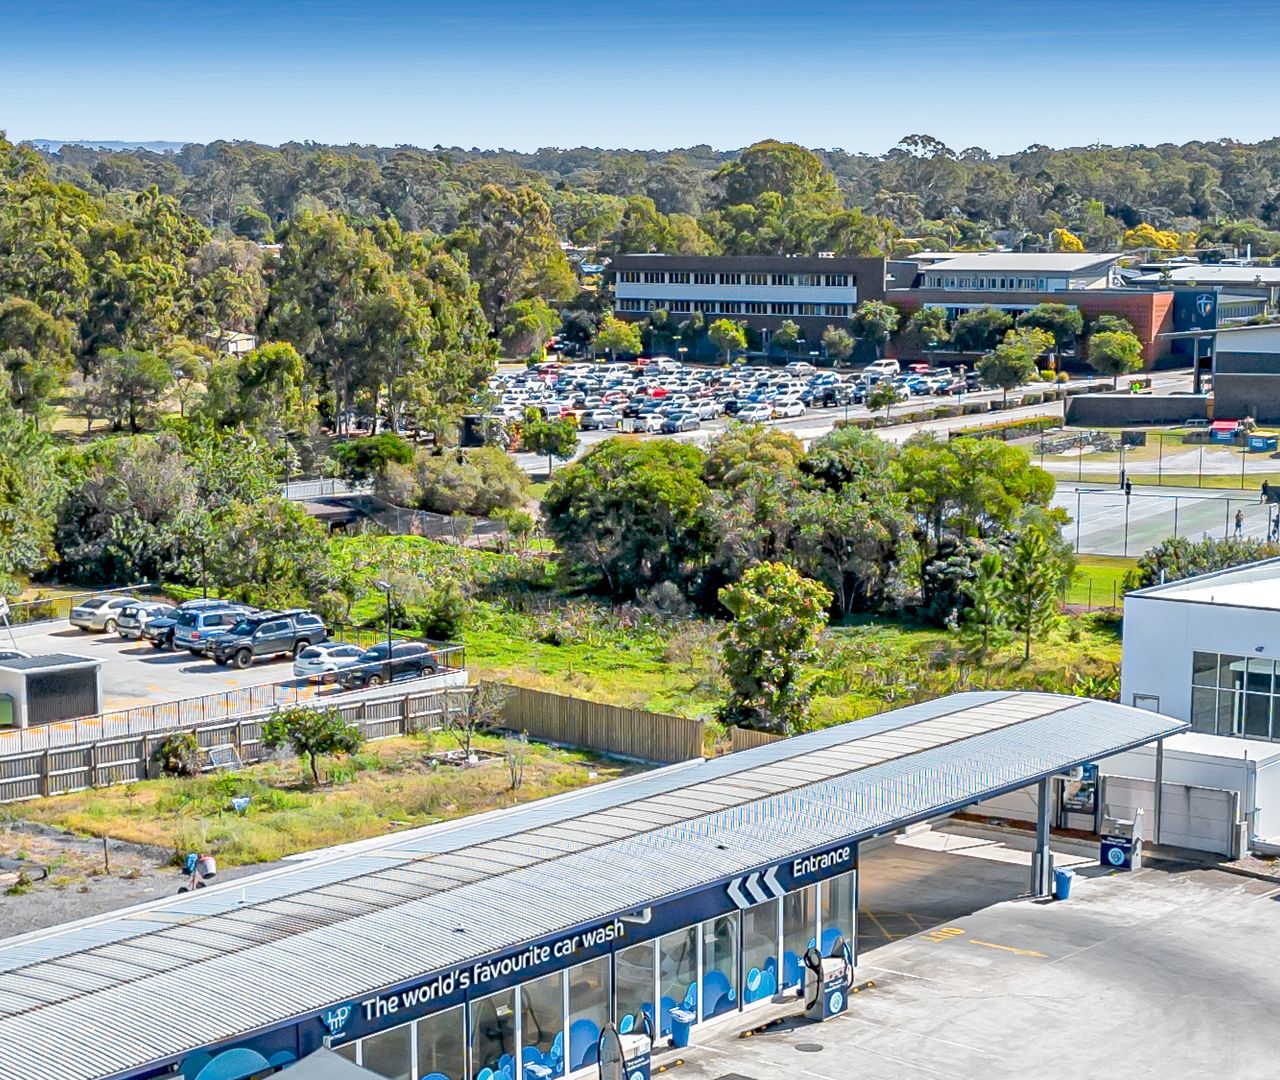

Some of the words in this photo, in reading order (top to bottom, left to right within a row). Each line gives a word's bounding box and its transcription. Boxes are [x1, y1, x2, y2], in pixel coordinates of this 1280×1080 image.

[793, 846, 850, 877] Entrance
[362, 995, 399, 1021] The
[402, 969, 470, 1010] world's
[473, 945, 551, 985] favourite
[553, 935, 579, 958] car
[582, 918, 624, 948] wash
